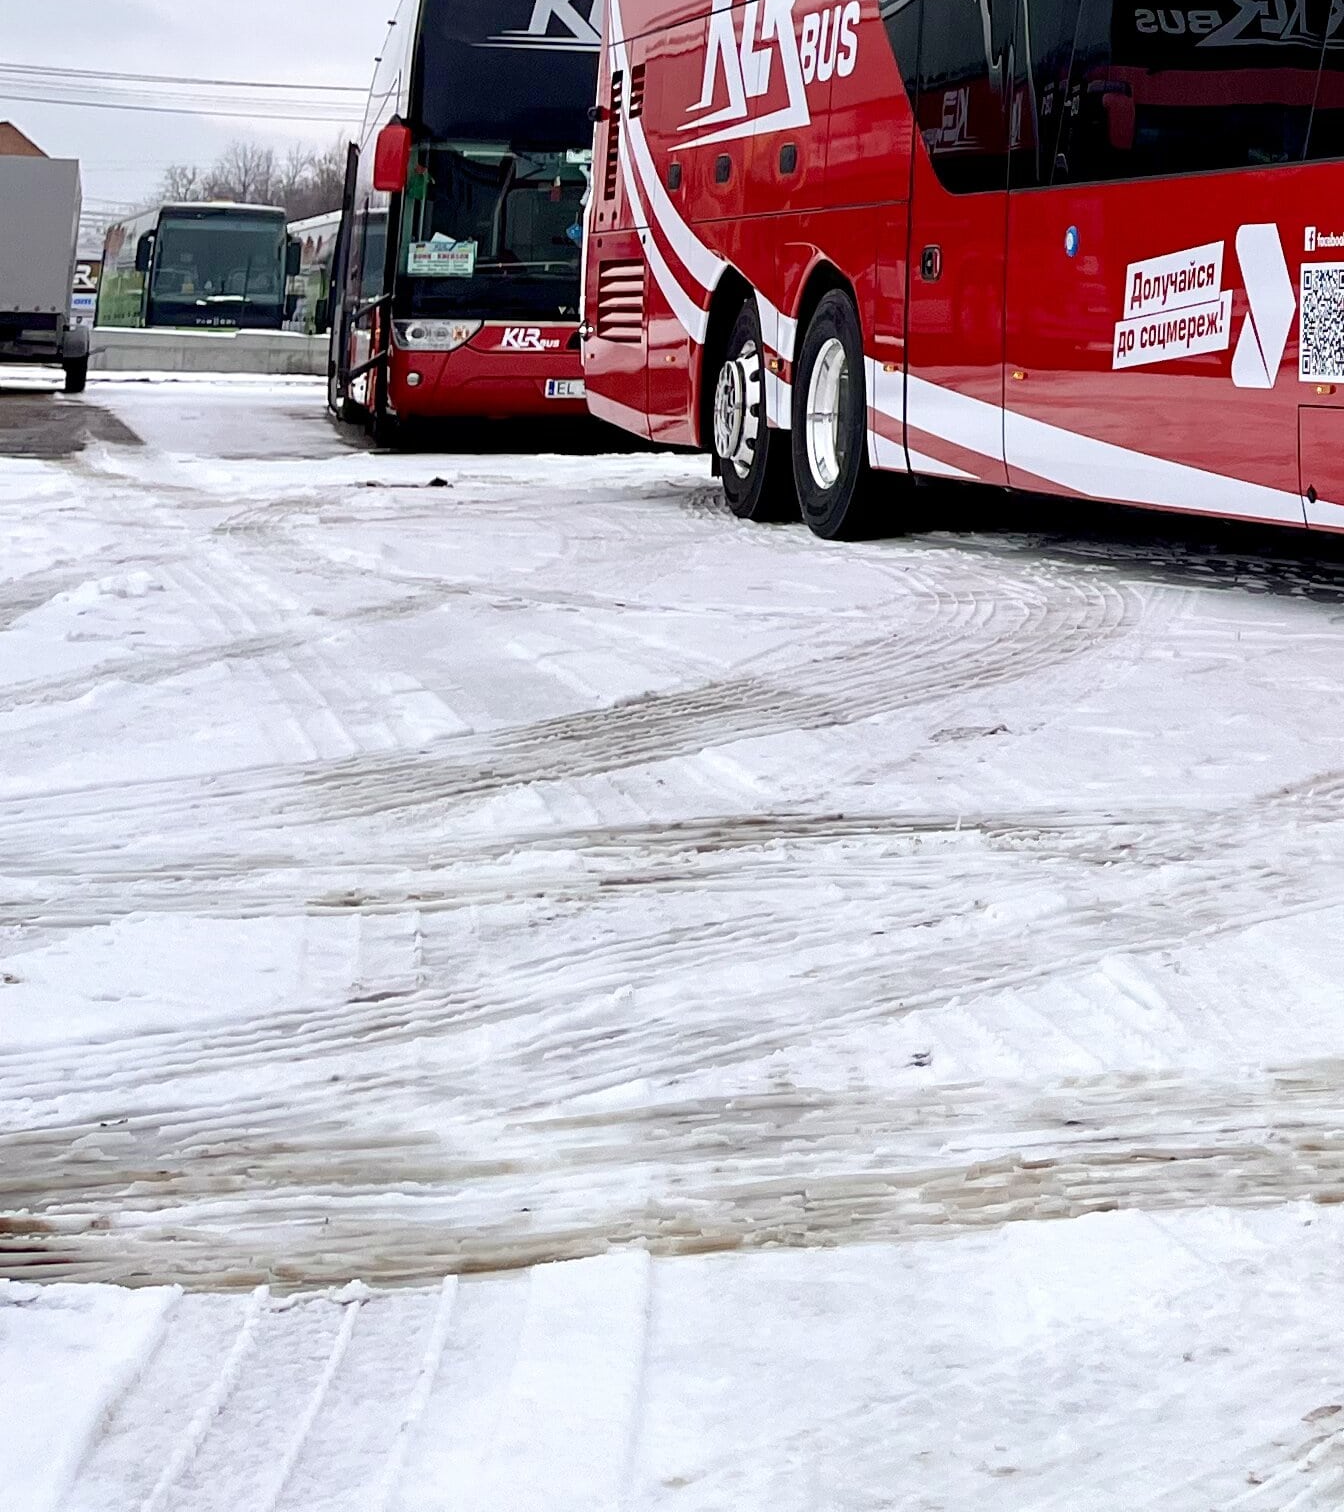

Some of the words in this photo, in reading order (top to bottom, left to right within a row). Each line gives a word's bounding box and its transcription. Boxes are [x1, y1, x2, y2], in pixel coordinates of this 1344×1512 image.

[800, 0, 861, 86] BUS
[1130, 259, 1216, 310] Долучайся
[502, 327, 545, 351] KLR
[1116, 329, 1135, 359] до
[1140, 301, 1225, 350] соцмереж!
